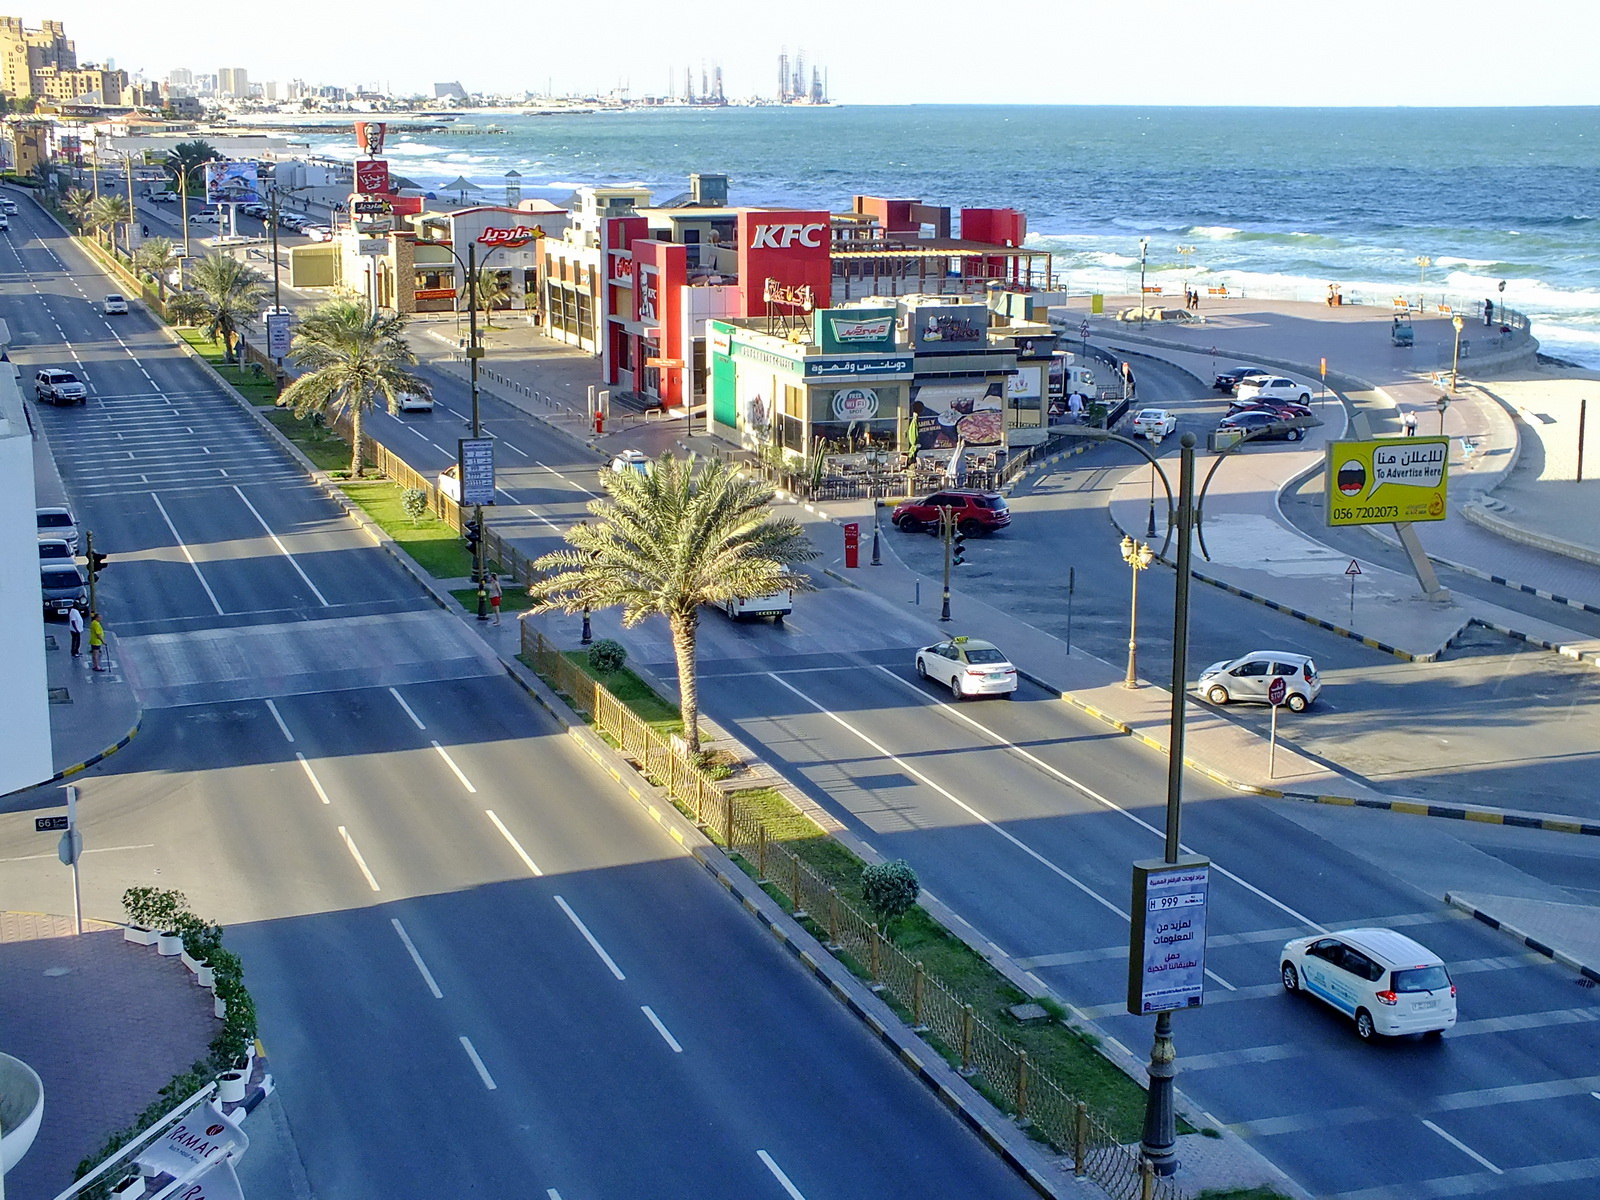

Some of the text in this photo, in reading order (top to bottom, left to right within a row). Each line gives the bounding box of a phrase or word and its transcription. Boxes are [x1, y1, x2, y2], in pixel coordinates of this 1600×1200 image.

[750, 223, 824, 249] KFC
[811, 360, 906, 375] دوناتس وقهوة
[1377, 450, 1443, 466] للإعلان هنا
[1376, 466, 1441, 479] To Advertise Here
[1333, 508, 1353, 519] 056
[1355, 506, 1399, 519] 7202073
[1270, 690, 1284, 700] STOP
[38, 818, 51, 828] 66
[1150, 900, 1156, 909] H
[1161, 896, 1179, 908] 999
[1156, 919, 1192, 934] لمزيد من
[1153, 931, 1194, 945] المعلومات
[1164, 953, 1180, 962] حمل
[1168, 960, 1197, 970] تطبيقاتنا
